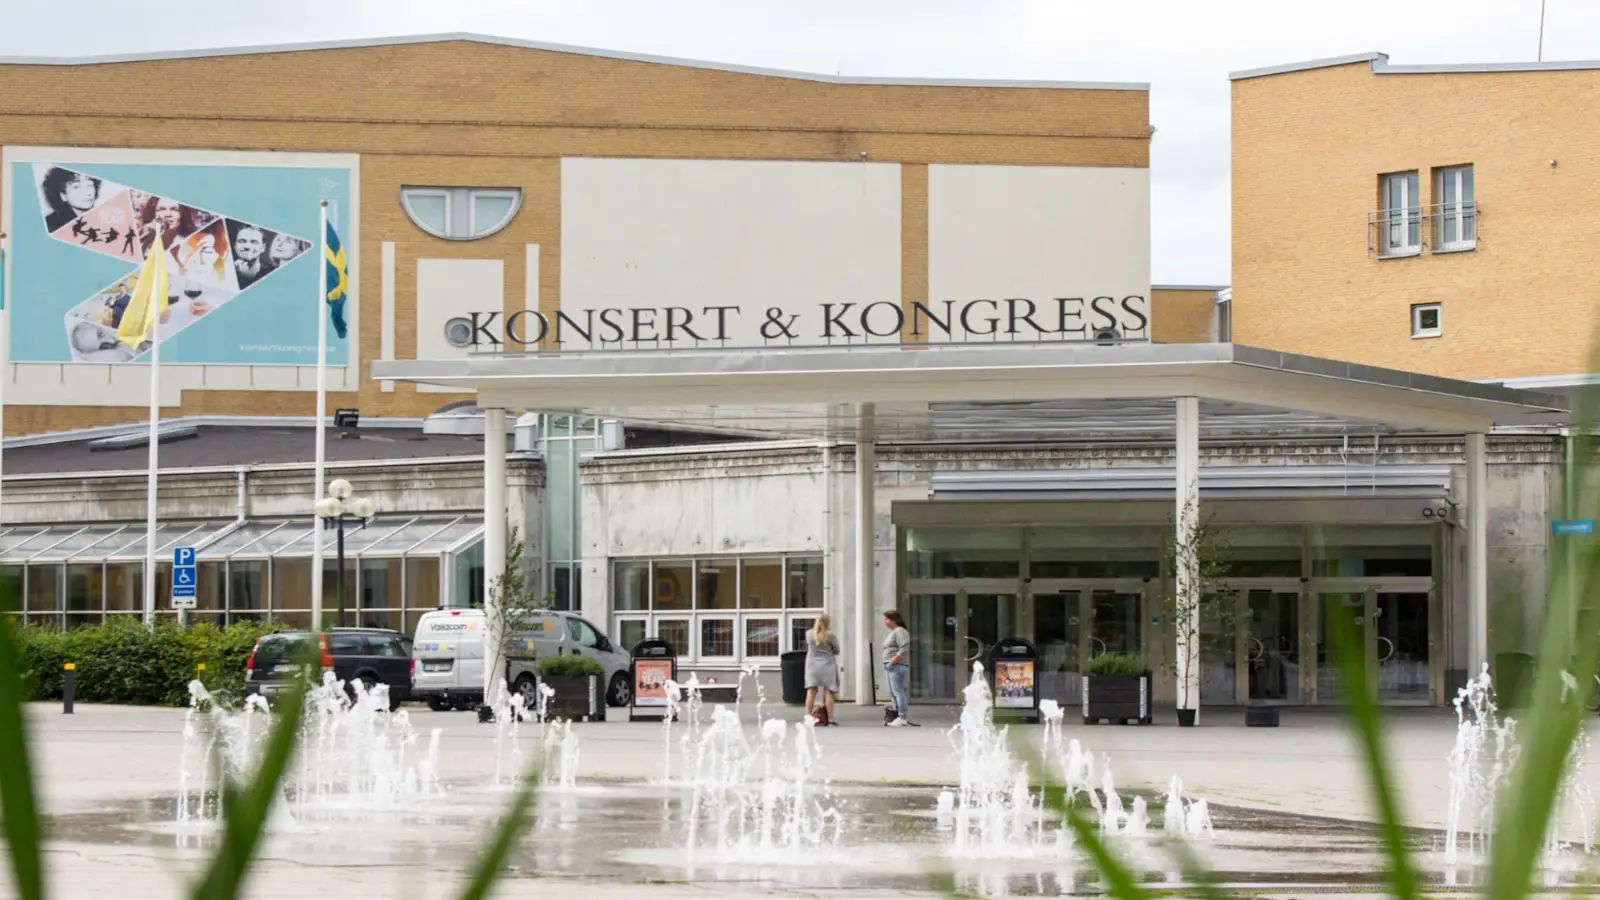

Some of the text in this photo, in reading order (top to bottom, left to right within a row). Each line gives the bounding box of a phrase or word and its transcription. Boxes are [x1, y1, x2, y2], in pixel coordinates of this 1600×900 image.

[467, 295, 1149, 345] KONSERT & KONGRESS
[180, 549, 191, 564] P
